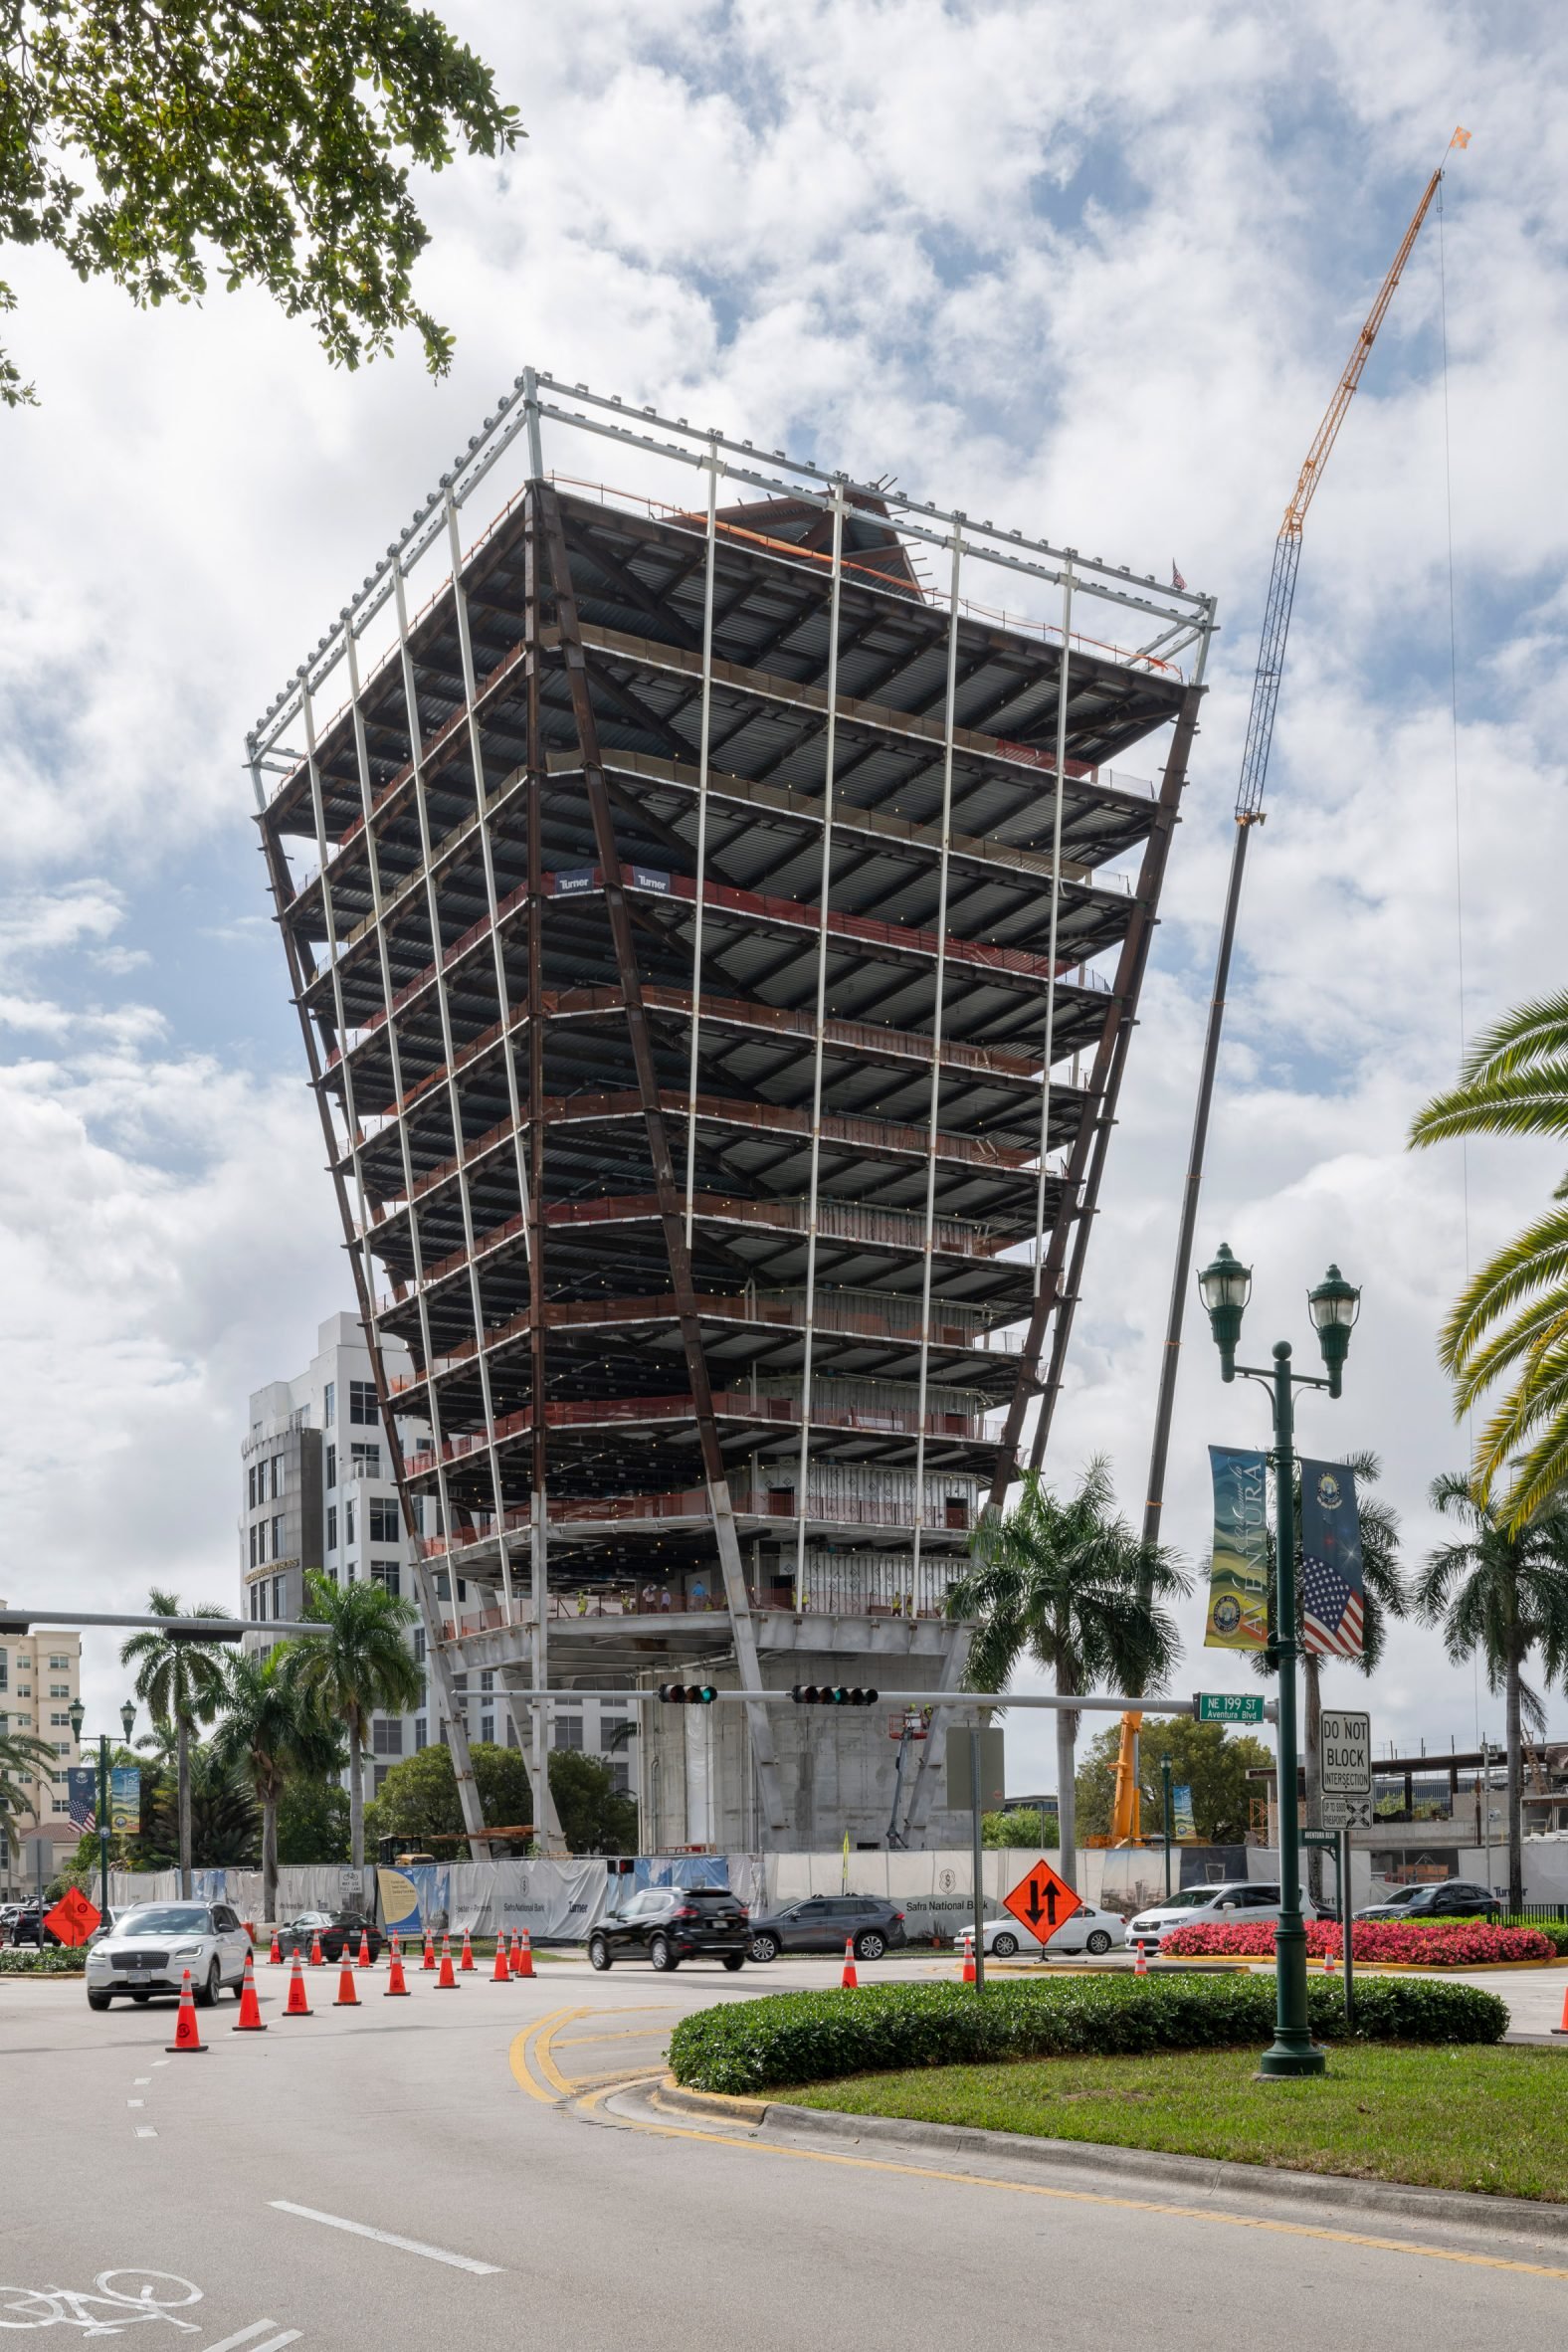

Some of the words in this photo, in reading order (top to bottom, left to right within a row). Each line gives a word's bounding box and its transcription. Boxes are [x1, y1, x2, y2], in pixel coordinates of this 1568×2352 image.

[559, 878, 589, 890] Turner
[638, 875, 667, 890] Turner
[1243, 1464, 1264, 1638] AVENTURA
[1208, 1697, 1220, 1709] NE
[1224, 1697, 1242, 1710] 199
[1246, 1698, 1257, 1710] ST
[1207, 1709, 1239, 1719] Aventura
[1242, 1710, 1257, 1719] Blvd
[1323, 1720, 1339, 1739] DO
[1344, 1721, 1367, 1740] NOT
[1326, 1748, 1364, 1767] BLOCK
[1324, 1772, 1368, 1786] INTERSECTION
[1304, 1831, 1324, 1840] AVENTURA
[1325, 1831, 1336, 1840] BLVD
[906, 1901, 927, 1912] Safra
[928, 1900, 964, 1911] National
[966, 1900, 989, 1910] Bk
